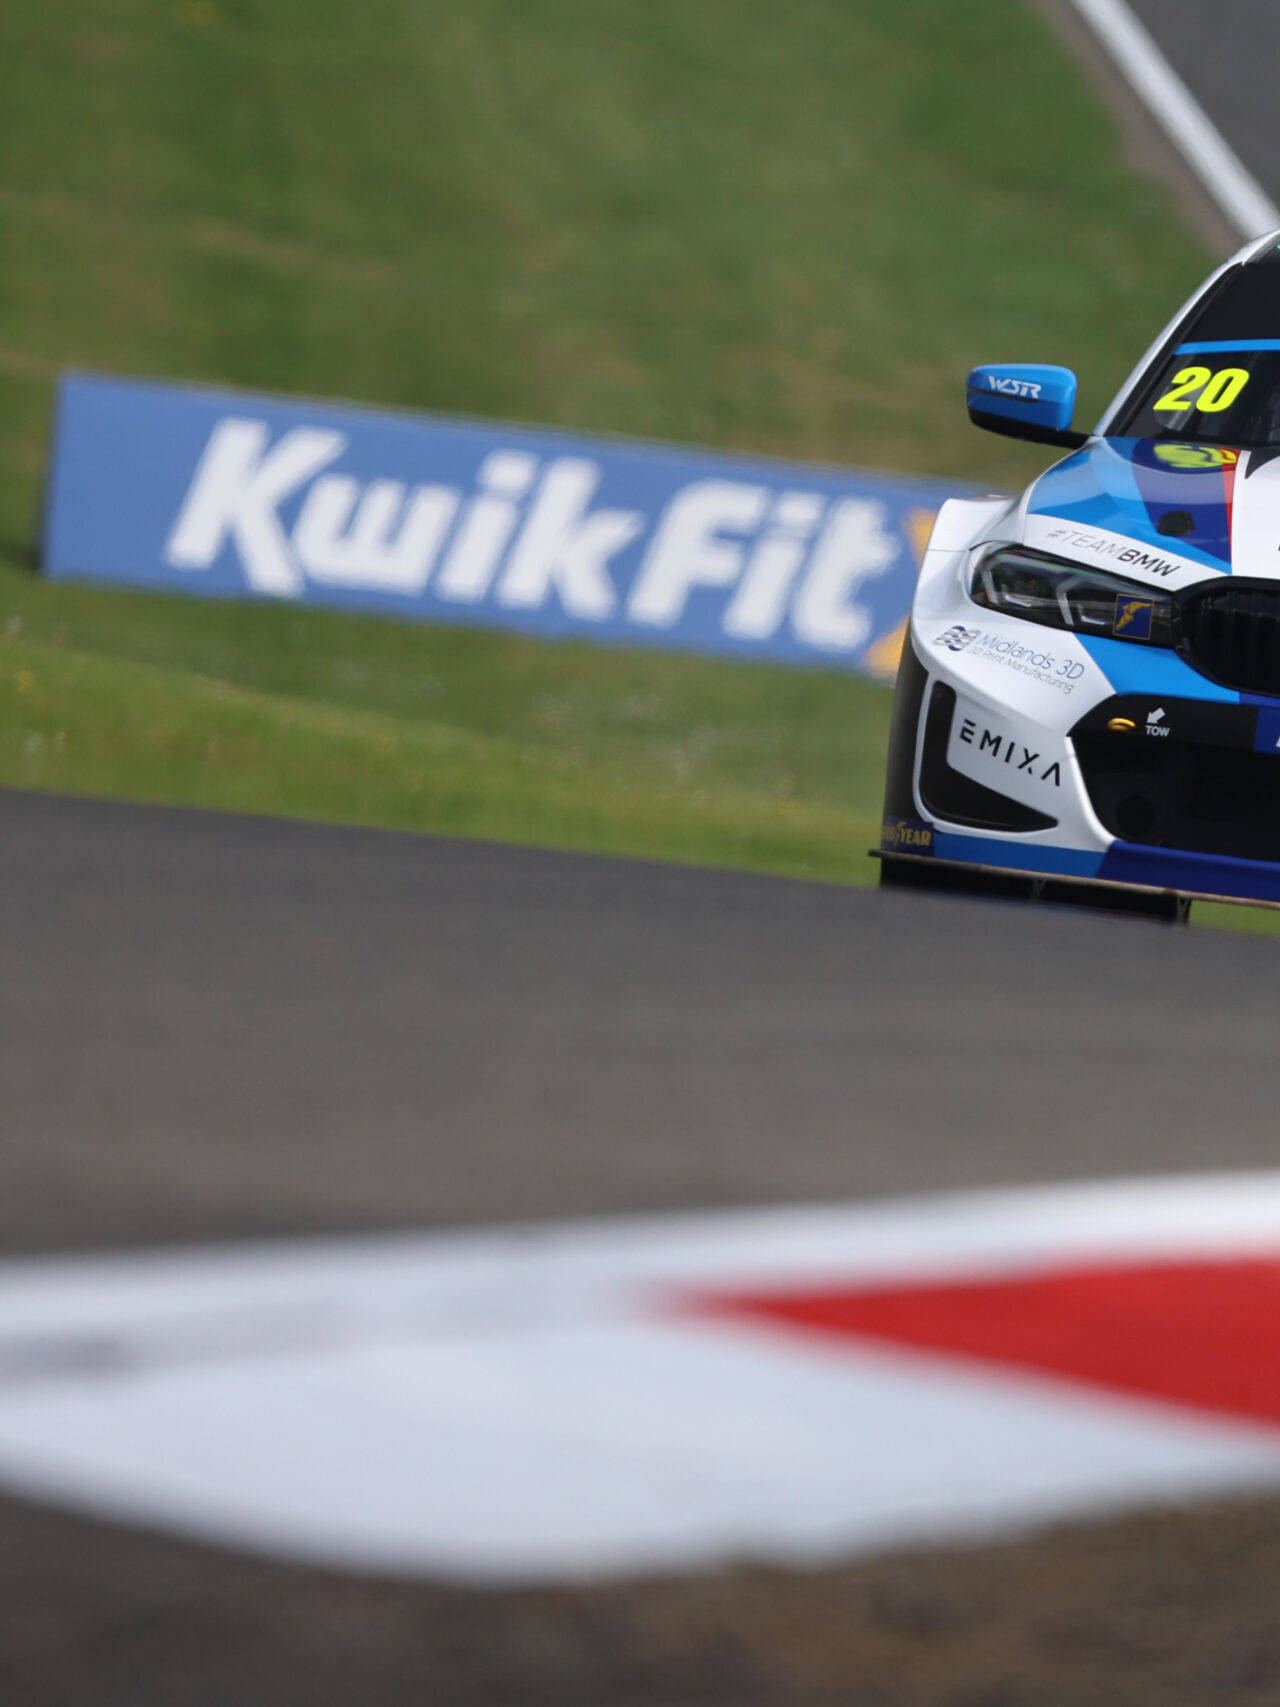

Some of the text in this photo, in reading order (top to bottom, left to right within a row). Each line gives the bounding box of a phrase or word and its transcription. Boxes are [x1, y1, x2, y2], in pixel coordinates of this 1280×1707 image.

[988, 376, 1042, 399] WSR
[1153, 366, 1250, 413] 20
[1045, 528, 1182, 576] #TEAMBMW
[977, 633, 1085, 680] Midlands 3D
[1005, 659, 1075, 695] Manufacturing
[958, 718, 1062, 787] EMIXA
[1145, 725, 1170, 737] TOW
